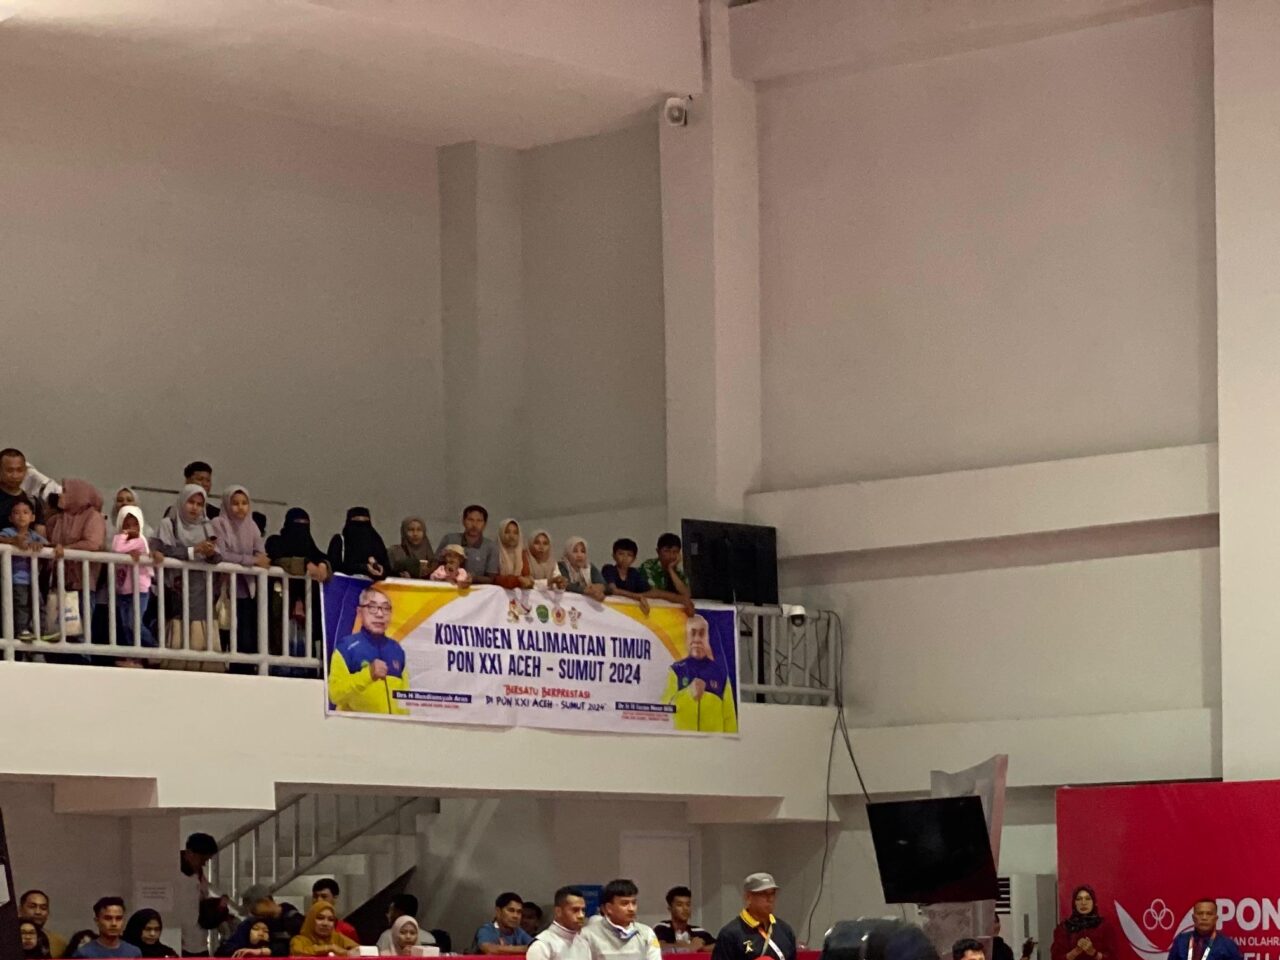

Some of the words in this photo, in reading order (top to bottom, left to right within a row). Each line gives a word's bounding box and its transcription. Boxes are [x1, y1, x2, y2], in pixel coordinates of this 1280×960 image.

[435, 623, 512, 650] KONTINGEN
[517, 629, 606, 657] KALIMANTAN
[610, 636, 651, 660] TIMUR
[447, 650, 475, 673] PON
[479, 652, 503, 675] XXI
[508, 654, 541, 677] ACEH
[559, 658, 604, 682] SUMUT
[609, 662, 641, 684] 2024
[496, 696, 512, 707] PON
[515, 697, 530, 707] XXI
[532, 698, 553, 709] ACEH
